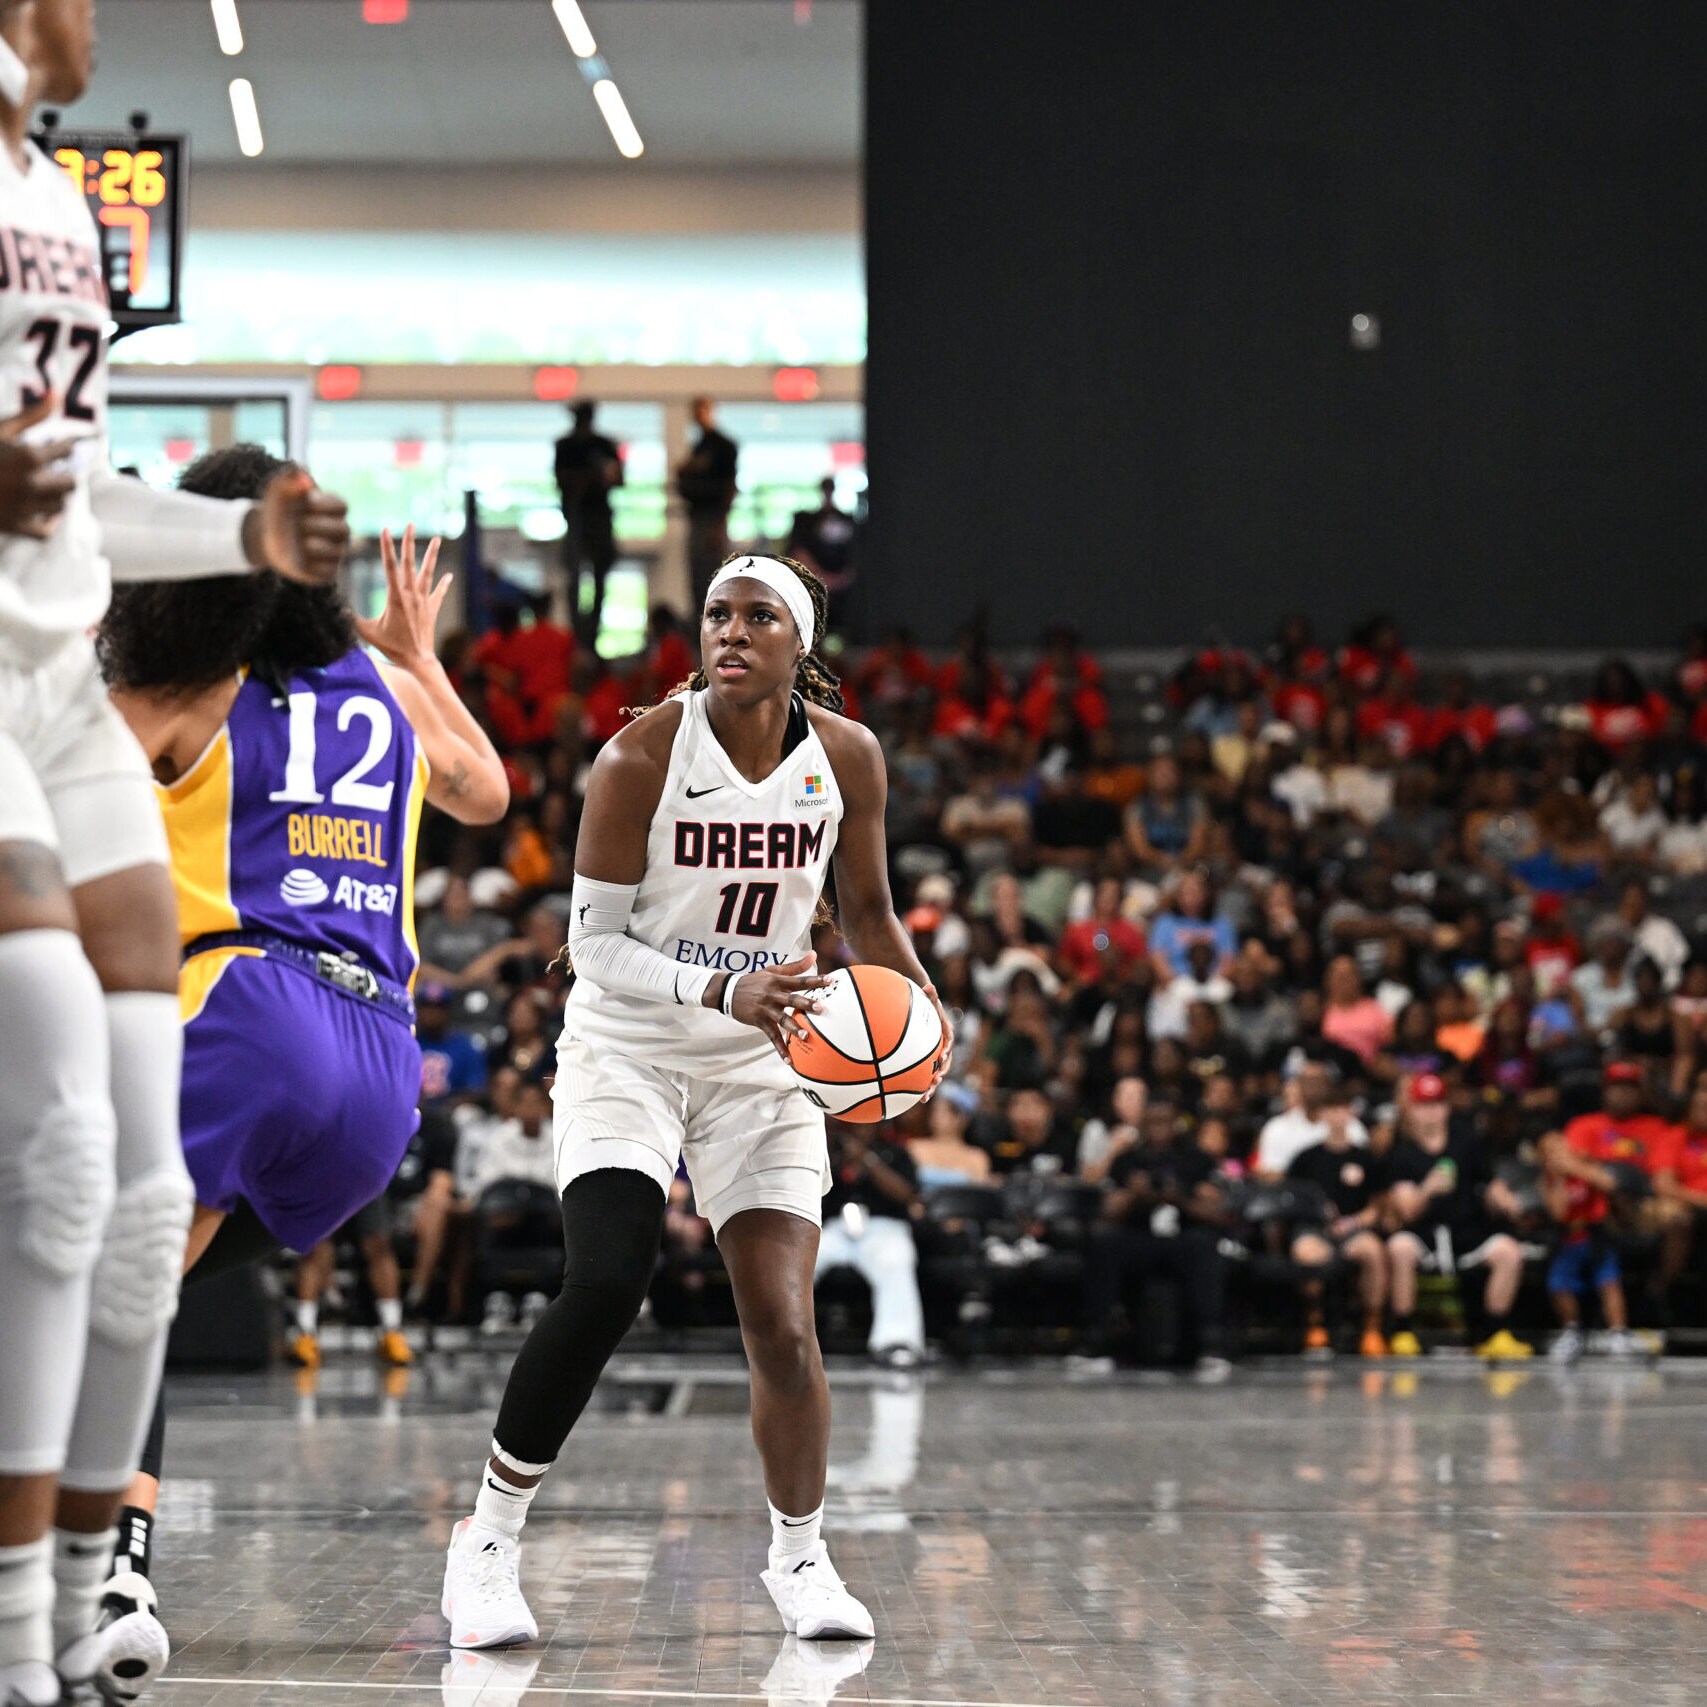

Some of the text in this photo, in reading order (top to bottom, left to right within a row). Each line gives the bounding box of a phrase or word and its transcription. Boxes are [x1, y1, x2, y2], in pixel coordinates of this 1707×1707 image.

[98, 206, 150, 295] 7
[21, 319, 100, 420] 32
[269, 692, 394, 811] 12
[289, 815, 387, 867] BURRELL
[673, 819, 827, 869] DREAM
[334, 876, 397, 916] AT&T
[715, 883, 779, 937] 10
